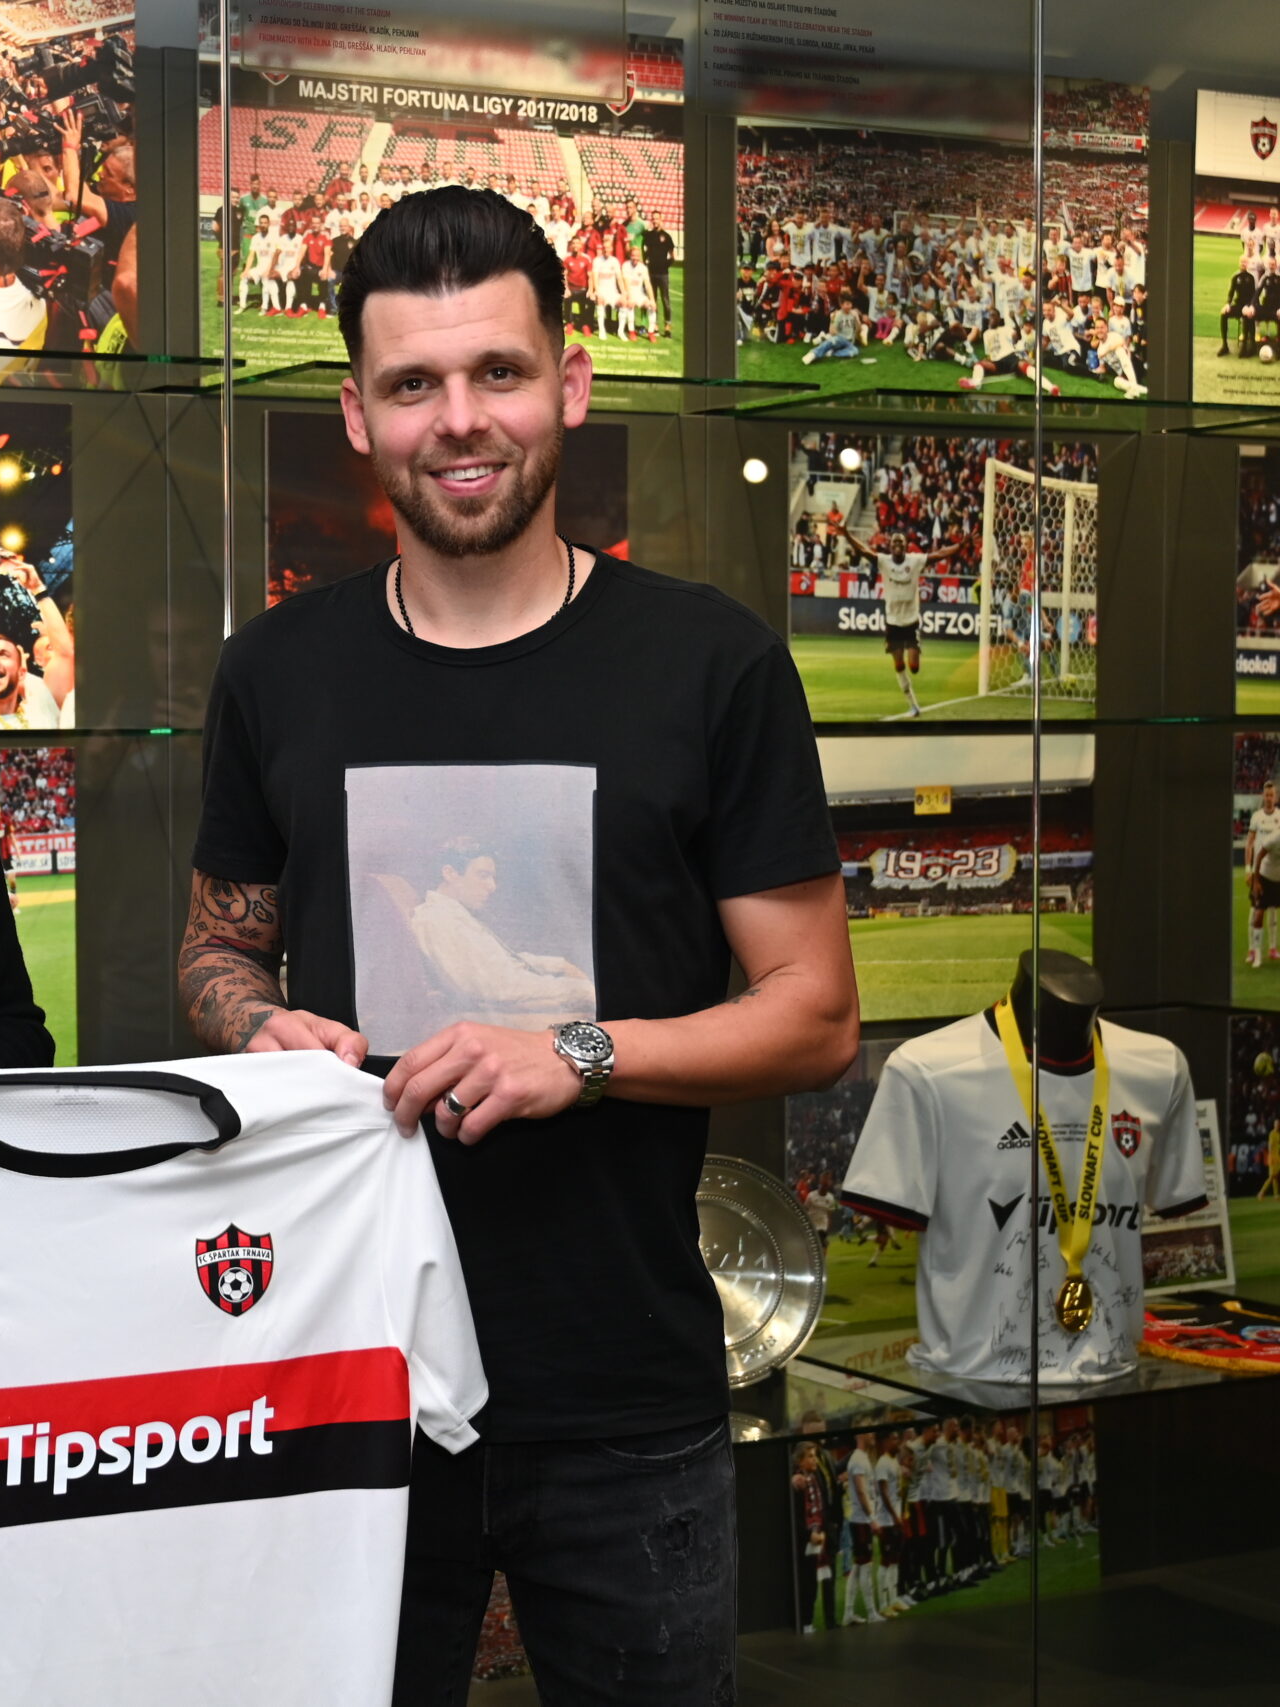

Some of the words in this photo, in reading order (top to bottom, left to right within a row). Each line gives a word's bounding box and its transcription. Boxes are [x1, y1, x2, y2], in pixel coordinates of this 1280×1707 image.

[355, 8, 365, 16] THE
[366, 8, 391, 18] STADIUM
[713, 12, 721, 21] THE
[392, 28, 419, 38] PEHLIVAN
[399, 46, 426, 56] PEHLIVAN
[298, 79, 378, 104] MAJSTRI
[383, 87, 470, 112] FORTUNA
[472, 95, 514, 116] LIGY
[517, 99, 598, 123] 2017/2018
[886, 850, 922, 879] 19
[950, 847, 1001, 879] 23
[996, 1139, 1031, 1150] adida
[1078, 1142, 1100, 1221] SLOVNAFT
[1090, 1105, 1104, 1138] CUP
[1053, 1192, 1070, 1223] CUP
[198, 1255, 208, 1265] FC
[208, 1249, 240, 1261] SPARTAK
[242, 1248, 271, 1259] TRNAVA
